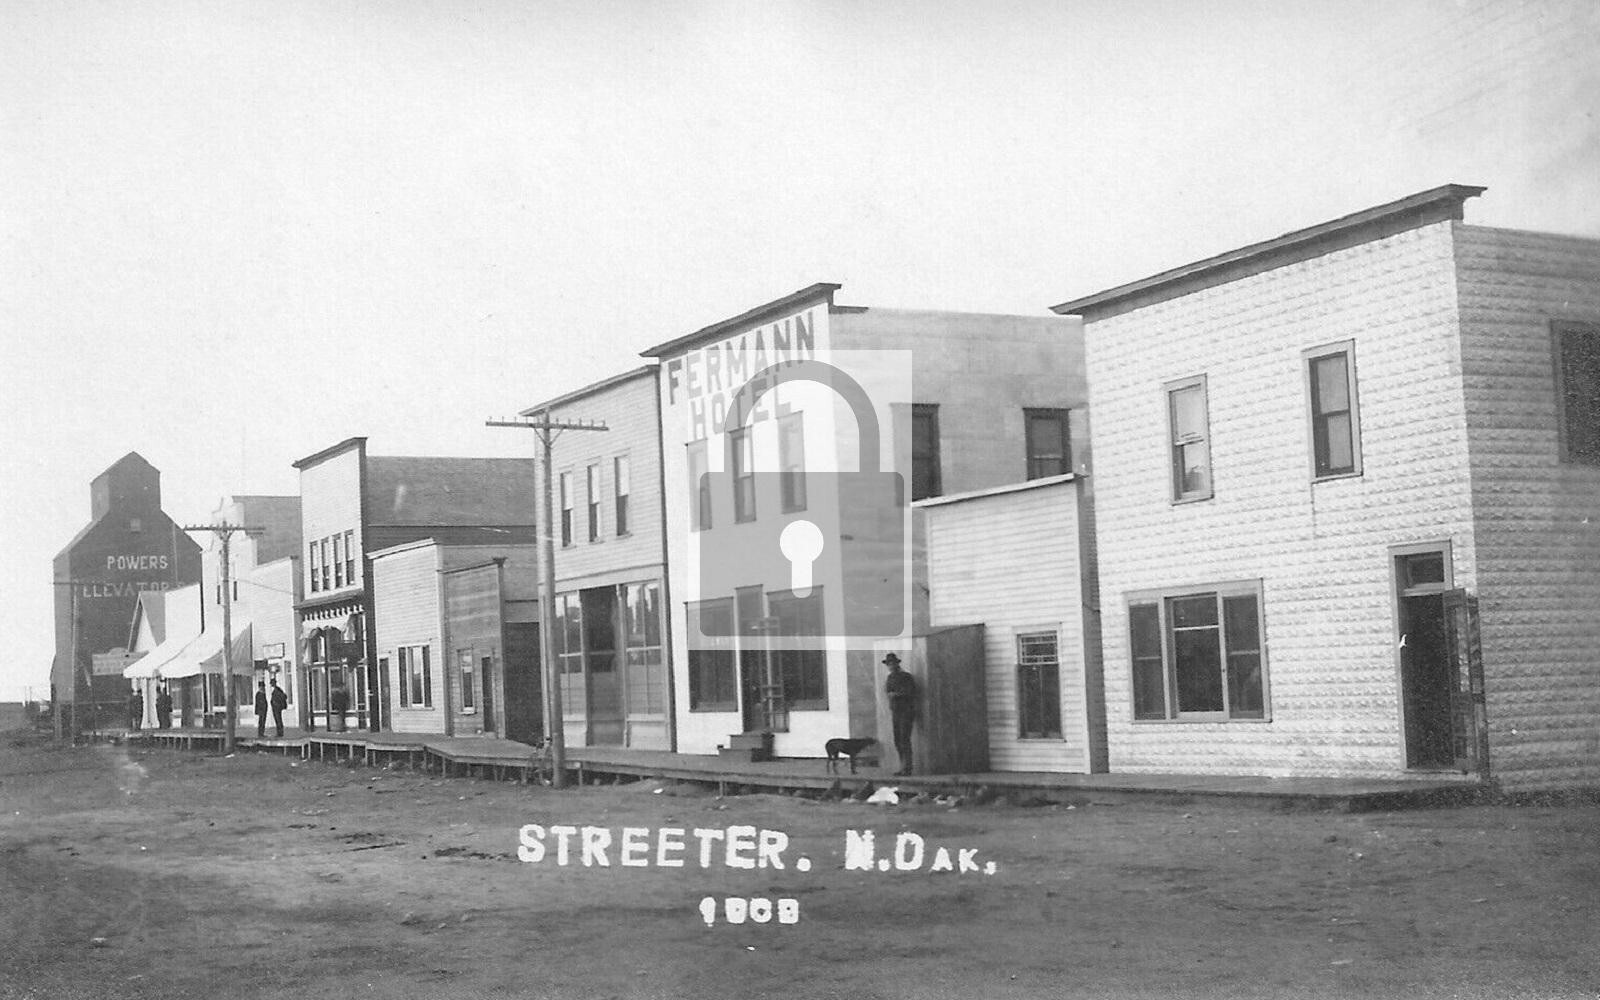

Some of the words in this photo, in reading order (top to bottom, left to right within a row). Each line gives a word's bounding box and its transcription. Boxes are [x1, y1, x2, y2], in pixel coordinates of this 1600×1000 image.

[667, 311, 815, 406] FERMANN
[690, 374, 792, 441] HOTEL
[107, 555, 169, 570] POWERS
